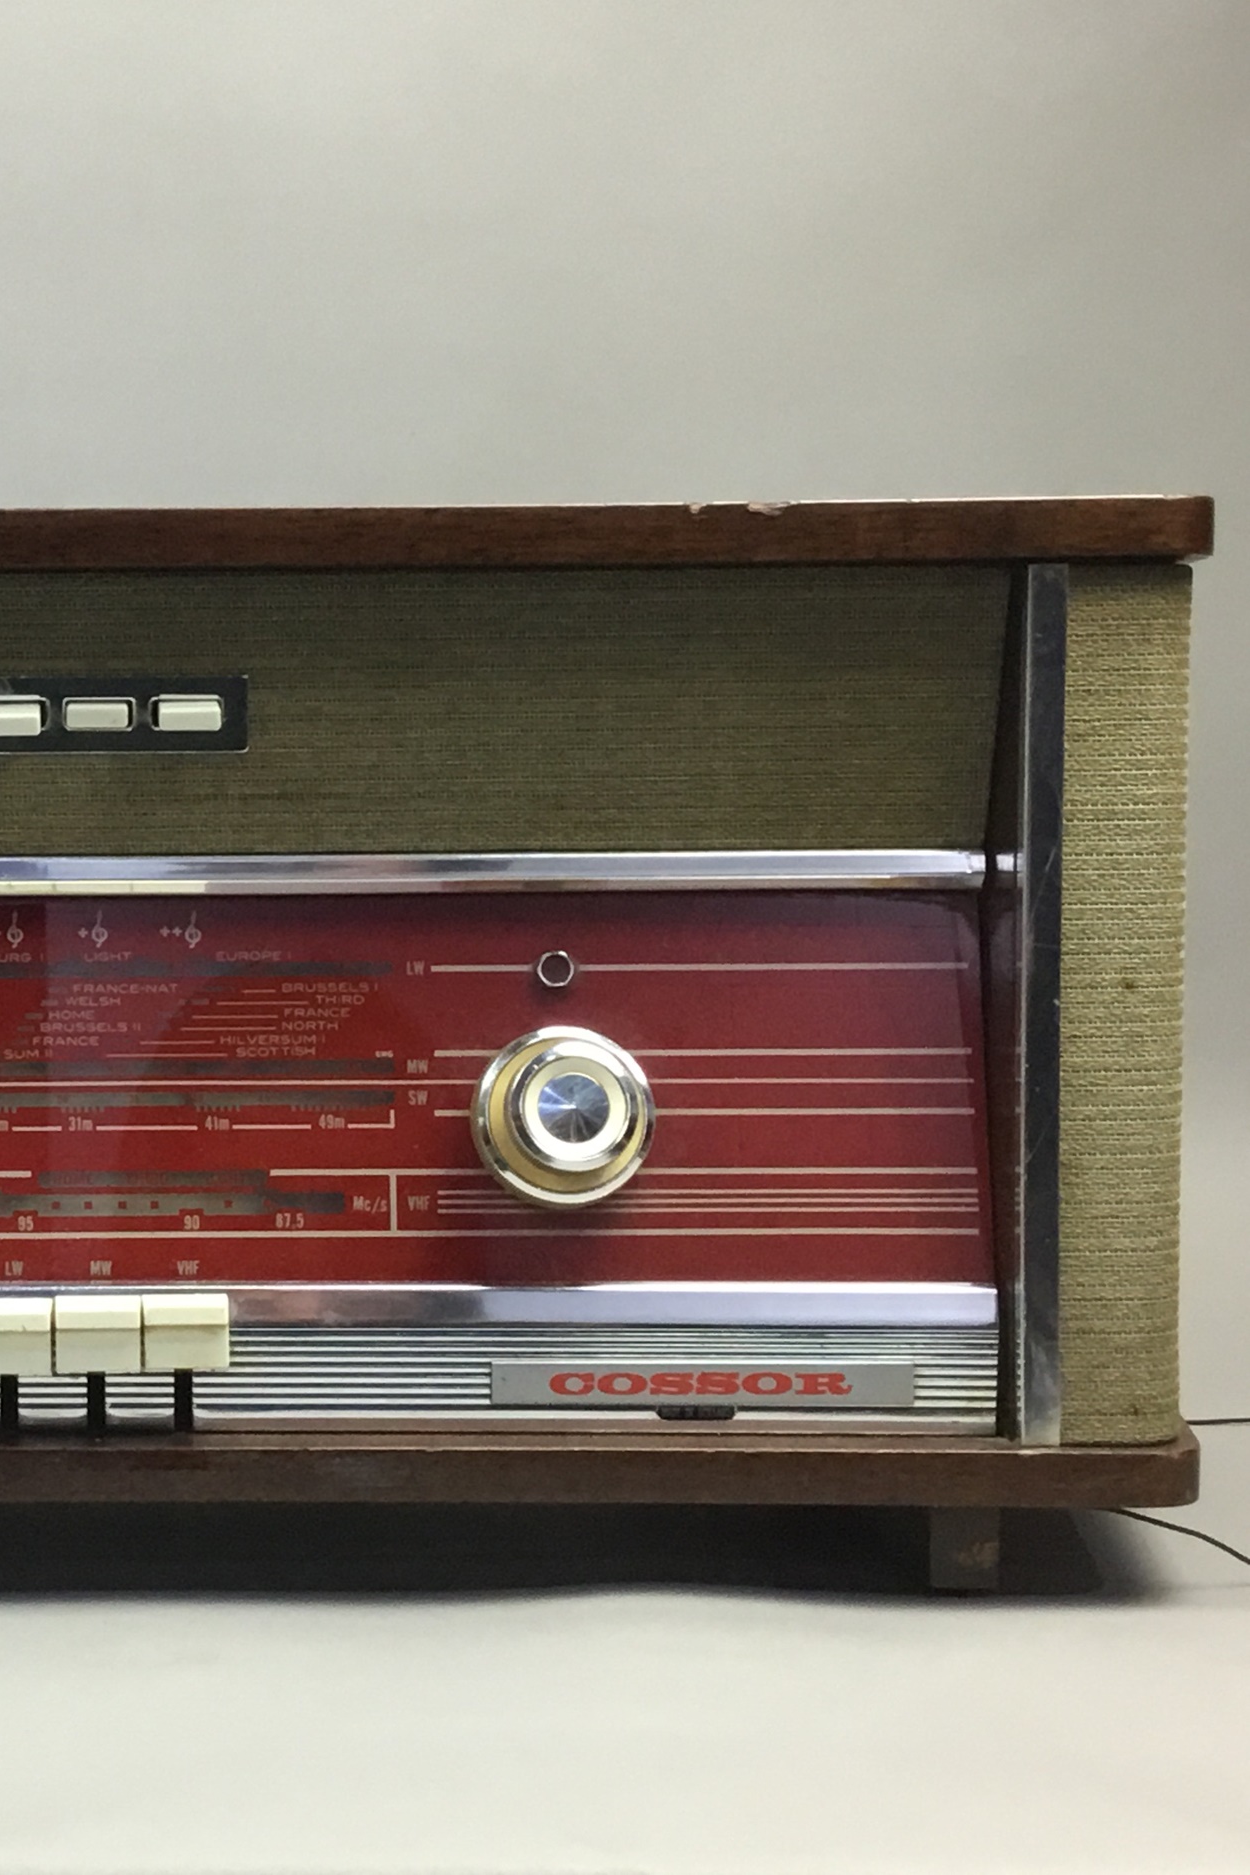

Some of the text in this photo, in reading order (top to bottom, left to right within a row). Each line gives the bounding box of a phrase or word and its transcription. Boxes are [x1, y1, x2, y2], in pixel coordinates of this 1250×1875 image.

[83, 952, 132, 962] LIGHT
[216, 951, 282, 961] EUROPE
[406, 961, 425, 976] LW
[72, 984, 178, 994] FRANCE-NAT
[281, 982, 370, 993] BRUSSELS
[64, 997, 122, 1007] WELSH
[315, 995, 365, 1005] THIRD
[48, 1010, 95, 1020] HOME
[283, 1008, 351, 1018] FRANCE
[39, 1022, 128, 1032] BRUSSELS
[281, 1021, 339, 1031] NORTH
[32, 1036, 100, 1046] FRANCE
[220, 1034, 317, 1045] HILVERSUM
[3, 1049, 39, 1060] SUM
[236, 1046, 316, 1057] SCOTTISH
[406, 1059, 429, 1074] MW
[408, 1091, 428, 1105] SW
[68, 1116, 93, 1131] 31m
[204, 1115, 230, 1131] 41m
[318, 1114, 345, 1129] 49m
[353, 1195, 387, 1214] Mc/s
[407, 1196, 430, 1211] VHF
[18, 1216, 34, 1231] 95
[184, 1215, 200, 1230] 90
[4, 1261, 23, 1276] LW
[90, 1260, 112, 1276] MW
[177, 1260, 200, 1275] VHF
[549, 1372, 853, 1396] COSSOR
